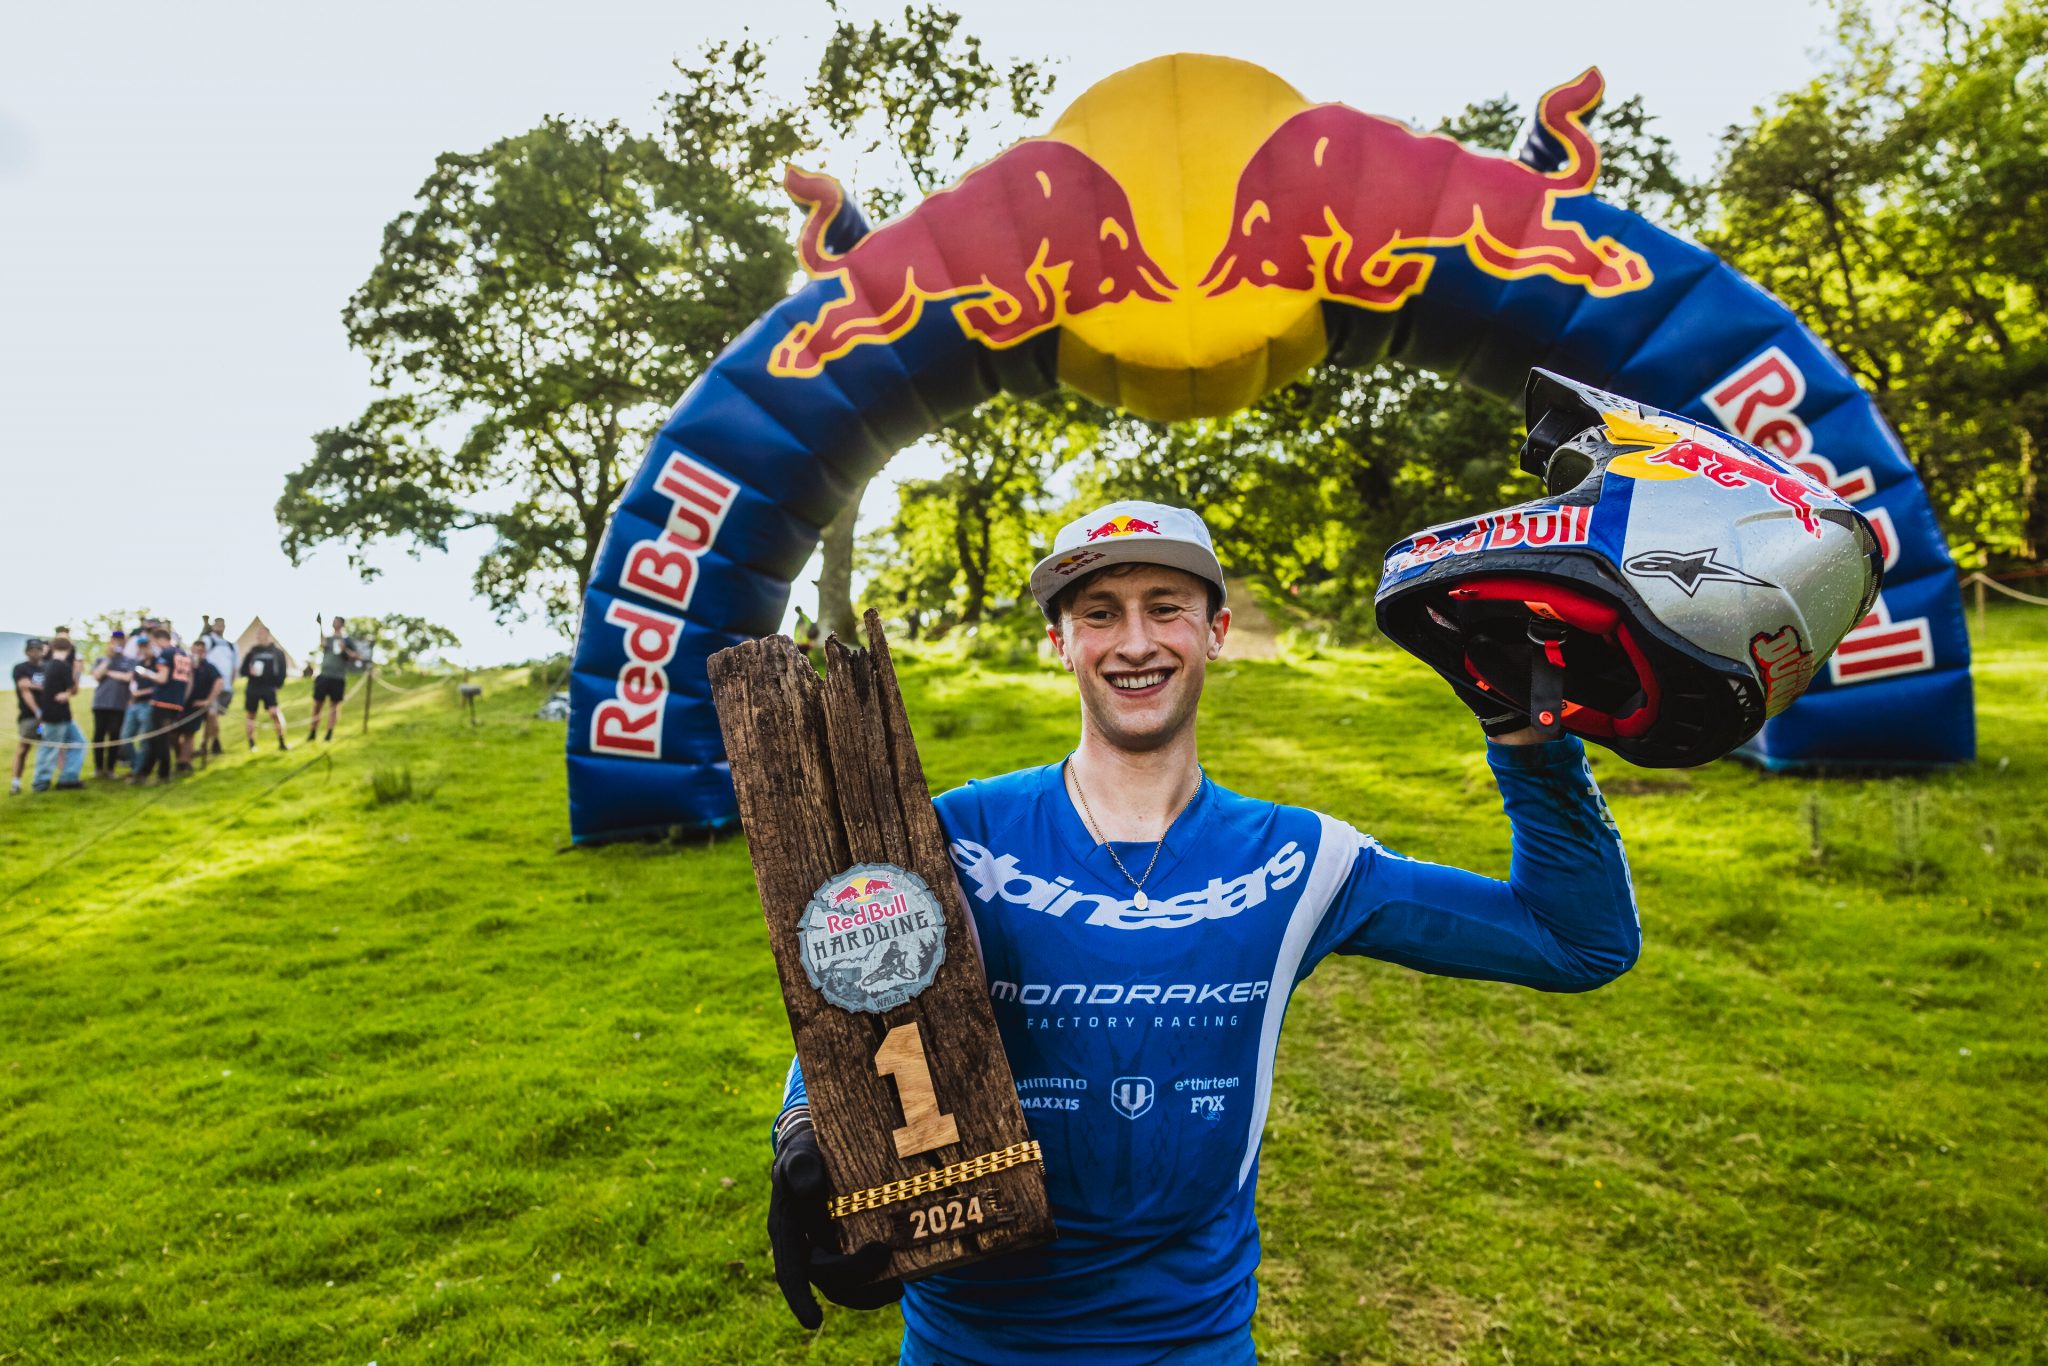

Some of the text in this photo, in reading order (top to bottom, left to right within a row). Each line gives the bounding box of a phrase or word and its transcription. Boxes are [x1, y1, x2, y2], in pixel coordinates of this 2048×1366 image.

[1489, 506, 1591, 548] Bull
[1710, 354, 1926, 679] Red ll
[594, 457, 734, 755] Red Bull
[949, 838, 1306, 931] alpinestars
[826, 894, 908, 934] Red Bull
[812, 910, 930, 961] HARDLINE
[873, 991, 907, 1009] WALES
[990, 980, 1270, 1006] MONDRAKER
[1026, 1015, 1239, 1030] FACTORY RACING
[874, 1021, 961, 1159] 1
[1016, 1077, 1088, 1091] HIMANO
[1190, 1095, 1225, 1121] FOX
[909, 1196, 984, 1240] 2024
